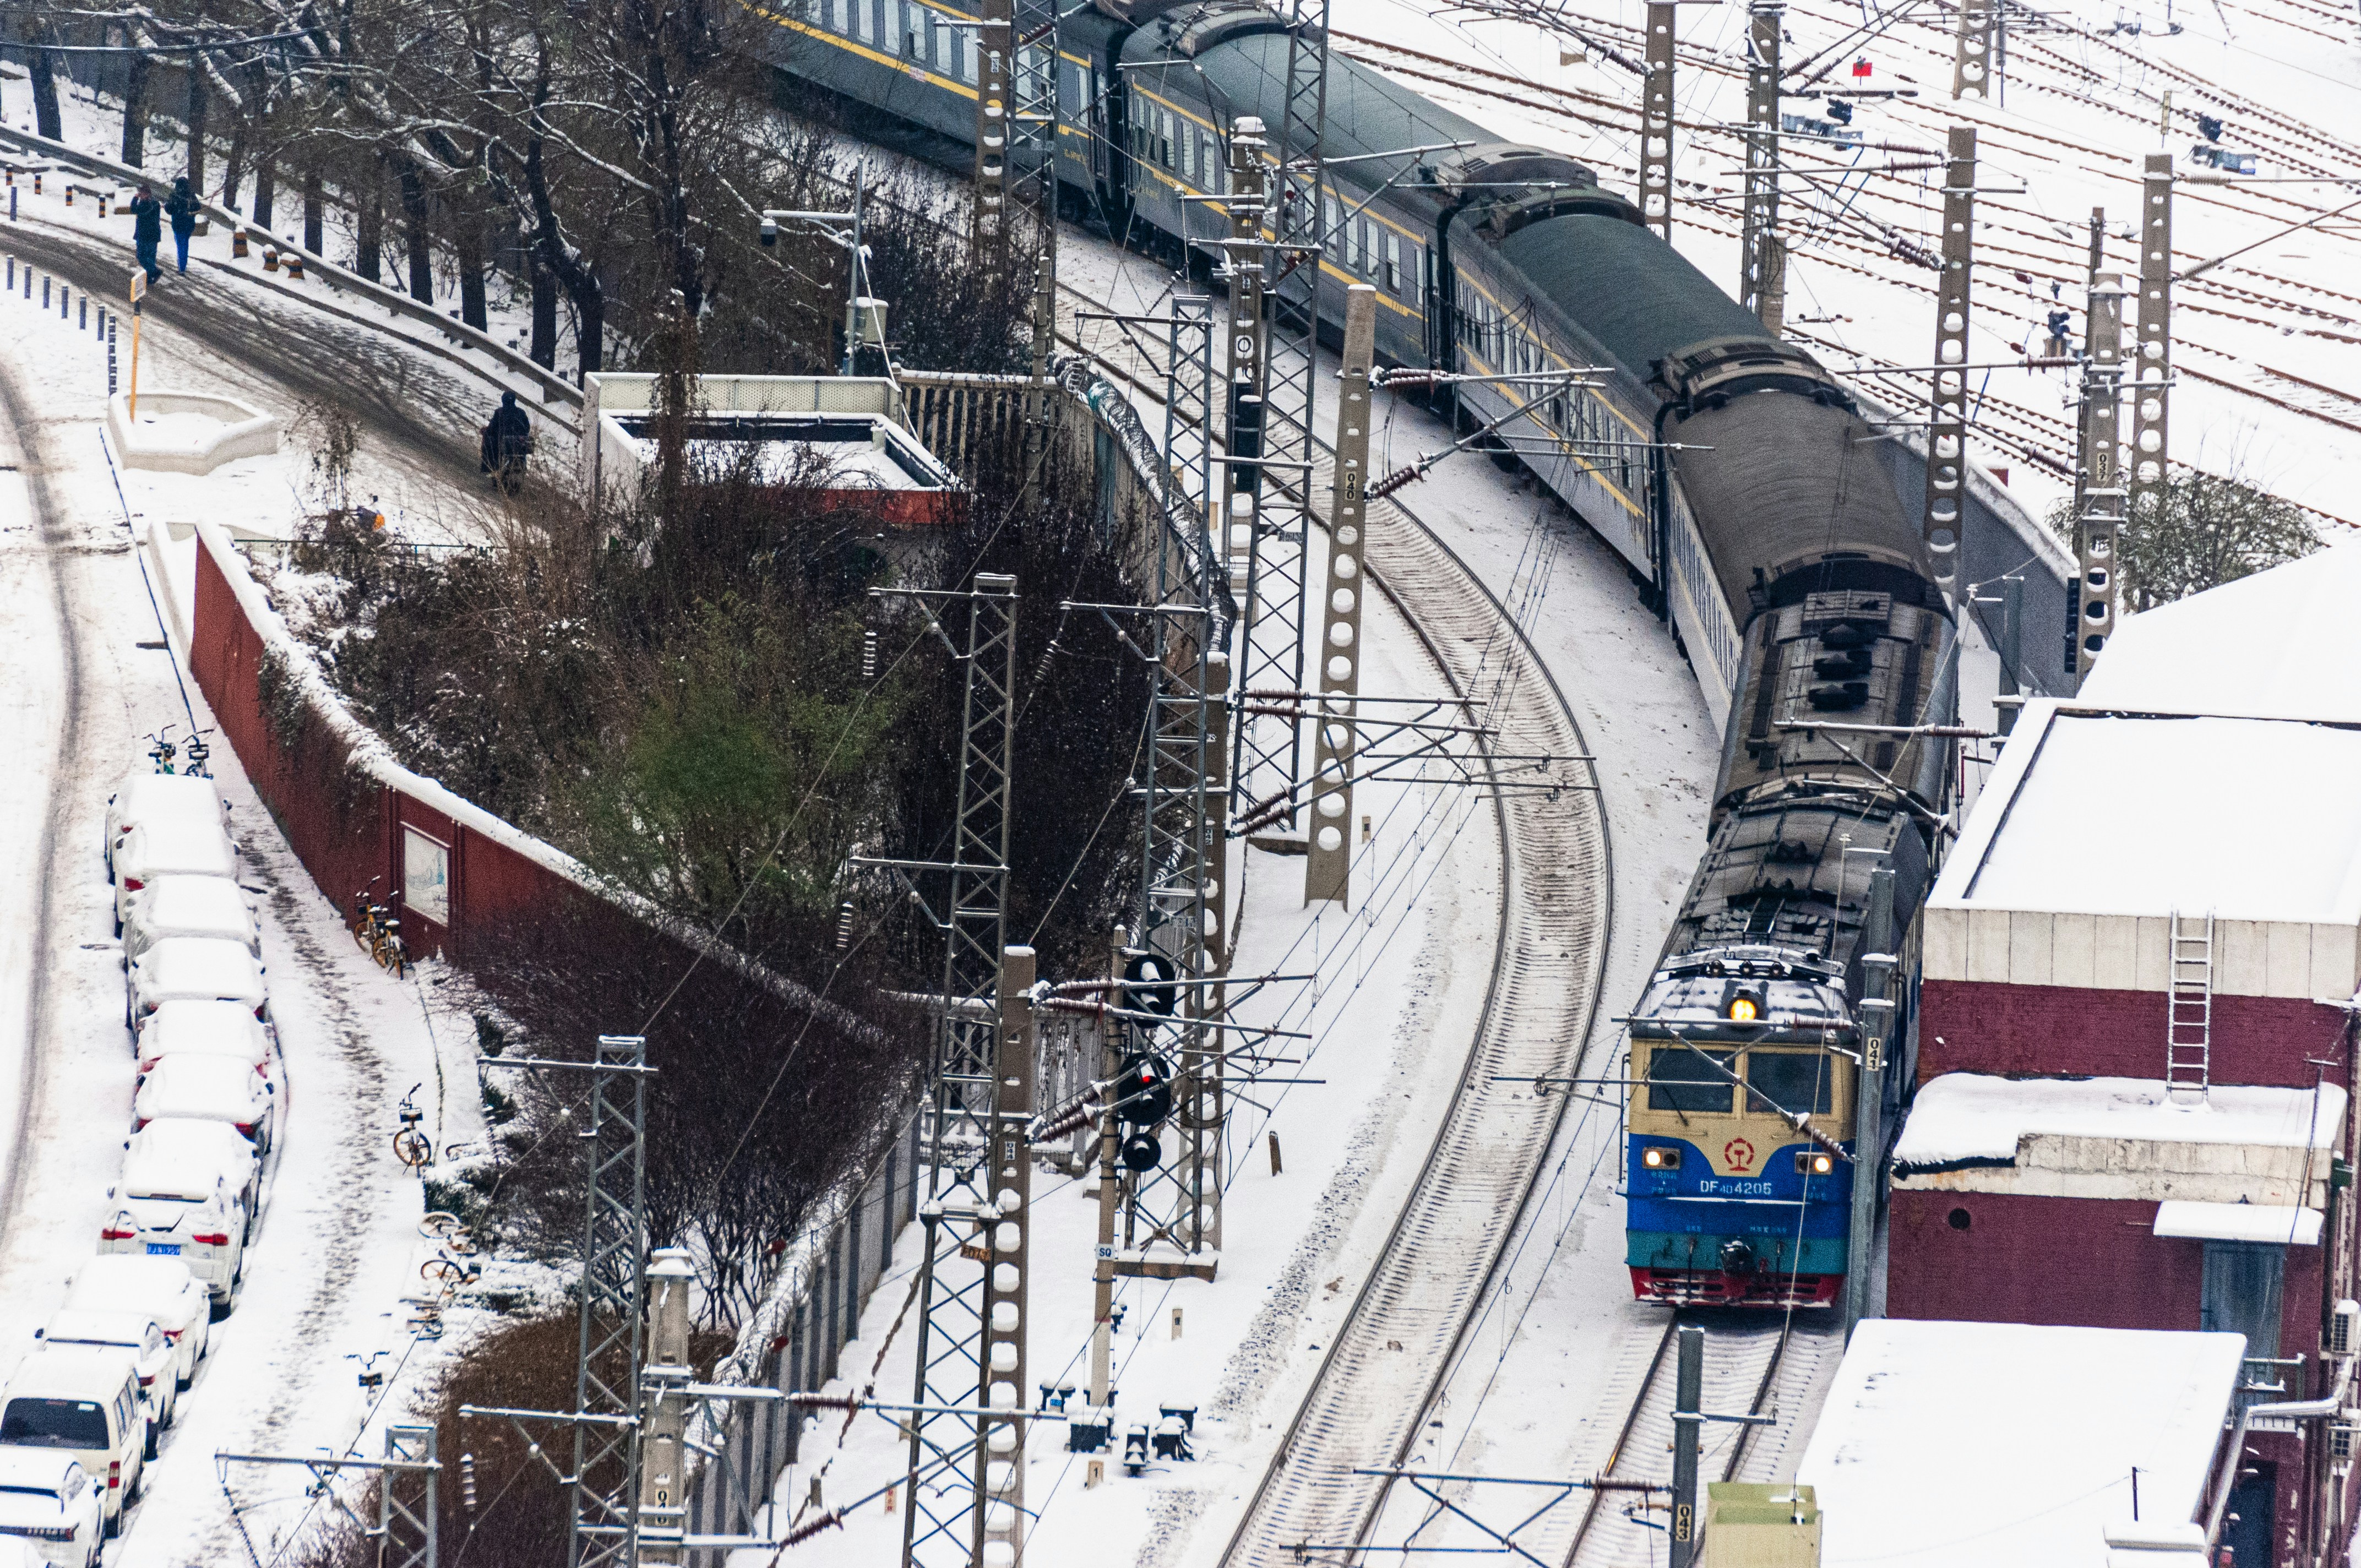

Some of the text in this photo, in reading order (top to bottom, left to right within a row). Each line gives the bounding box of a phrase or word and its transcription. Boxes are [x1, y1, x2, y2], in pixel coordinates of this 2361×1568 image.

[2099, 454, 2107, 480] 037
[1347, 473, 1356, 499] 040
[1869, 1039, 1879, 1069] 041
[1100, 1248, 1111, 1257] SQ
[1094, 1467, 1098, 1478] 1
[1679, 1506, 1690, 1540] 043
